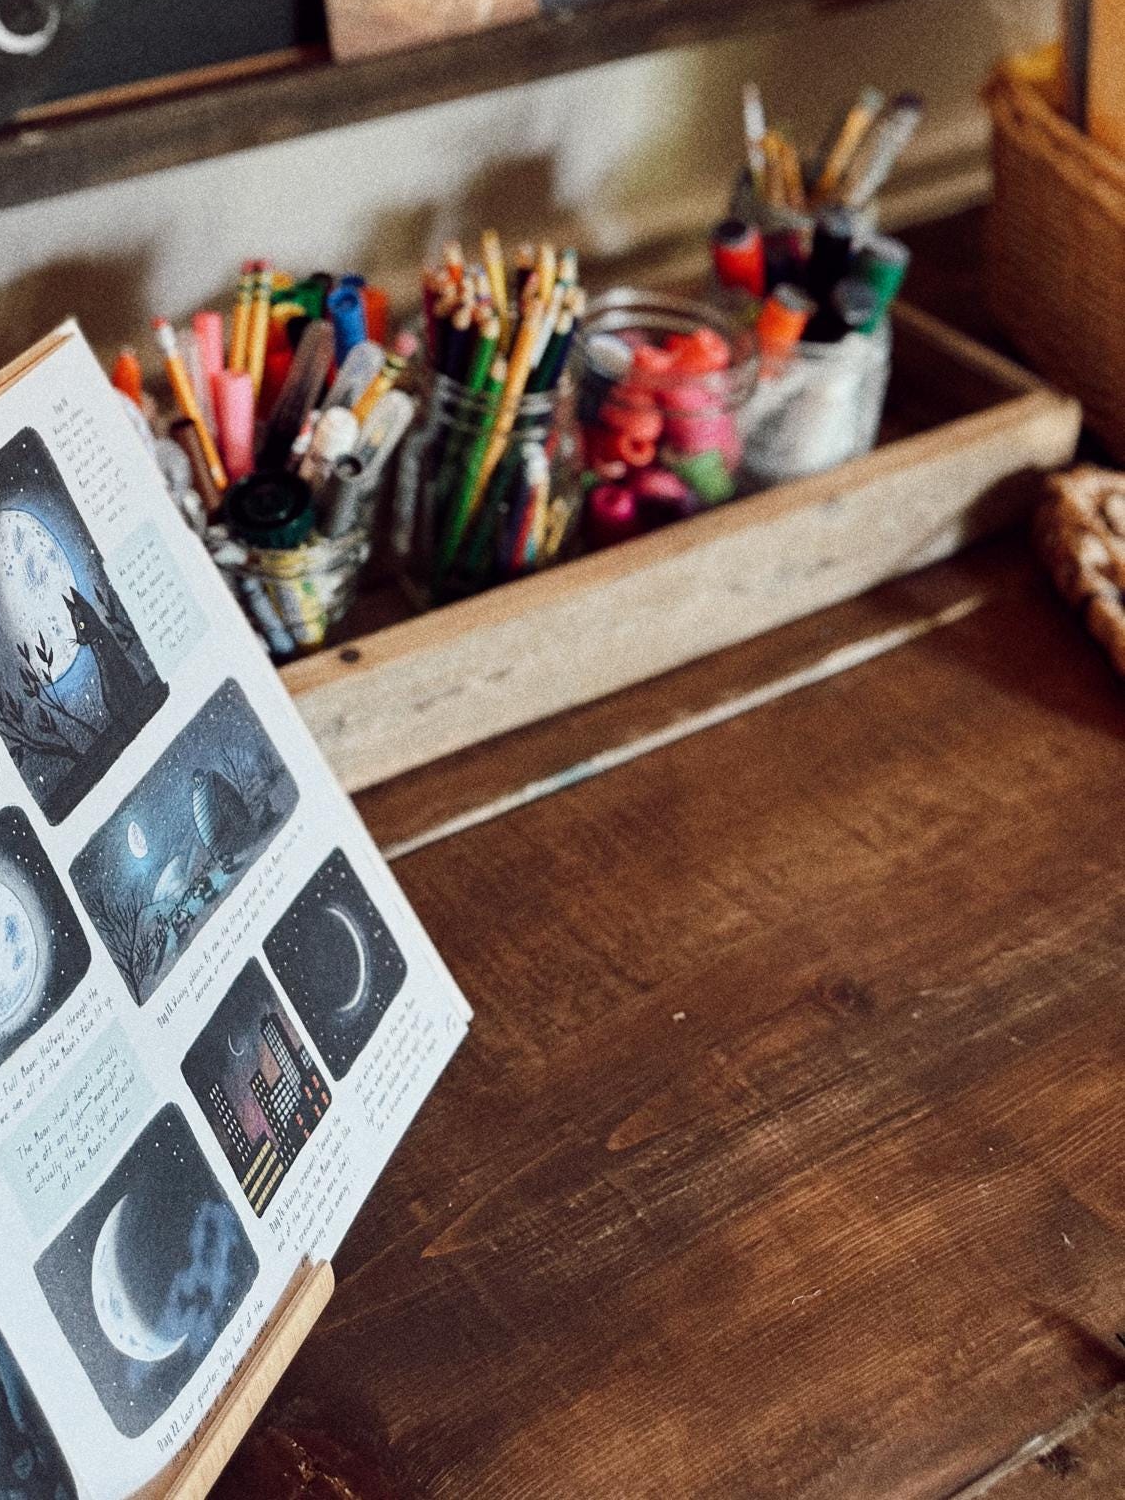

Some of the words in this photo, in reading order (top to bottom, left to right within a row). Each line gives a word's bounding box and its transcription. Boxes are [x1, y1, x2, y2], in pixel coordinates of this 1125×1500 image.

[2, 1073, 19, 1096] Full
[39, 1027, 65, 1060] Halfway
[26, 1079, 36, 1099] all
[38, 1068, 45, 1086] of
[48, 1057, 60, 1074] the
[15, 1141, 33, 1161] The
[34, 1123, 52, 1146] Moon
[42, 1140, 53, 1162] off
[34, 1160, 63, 1195] actually
[64, 1145, 77, 1161] the
[61, 1169, 72, 1192] off
[74, 1159, 87, 1174] the
